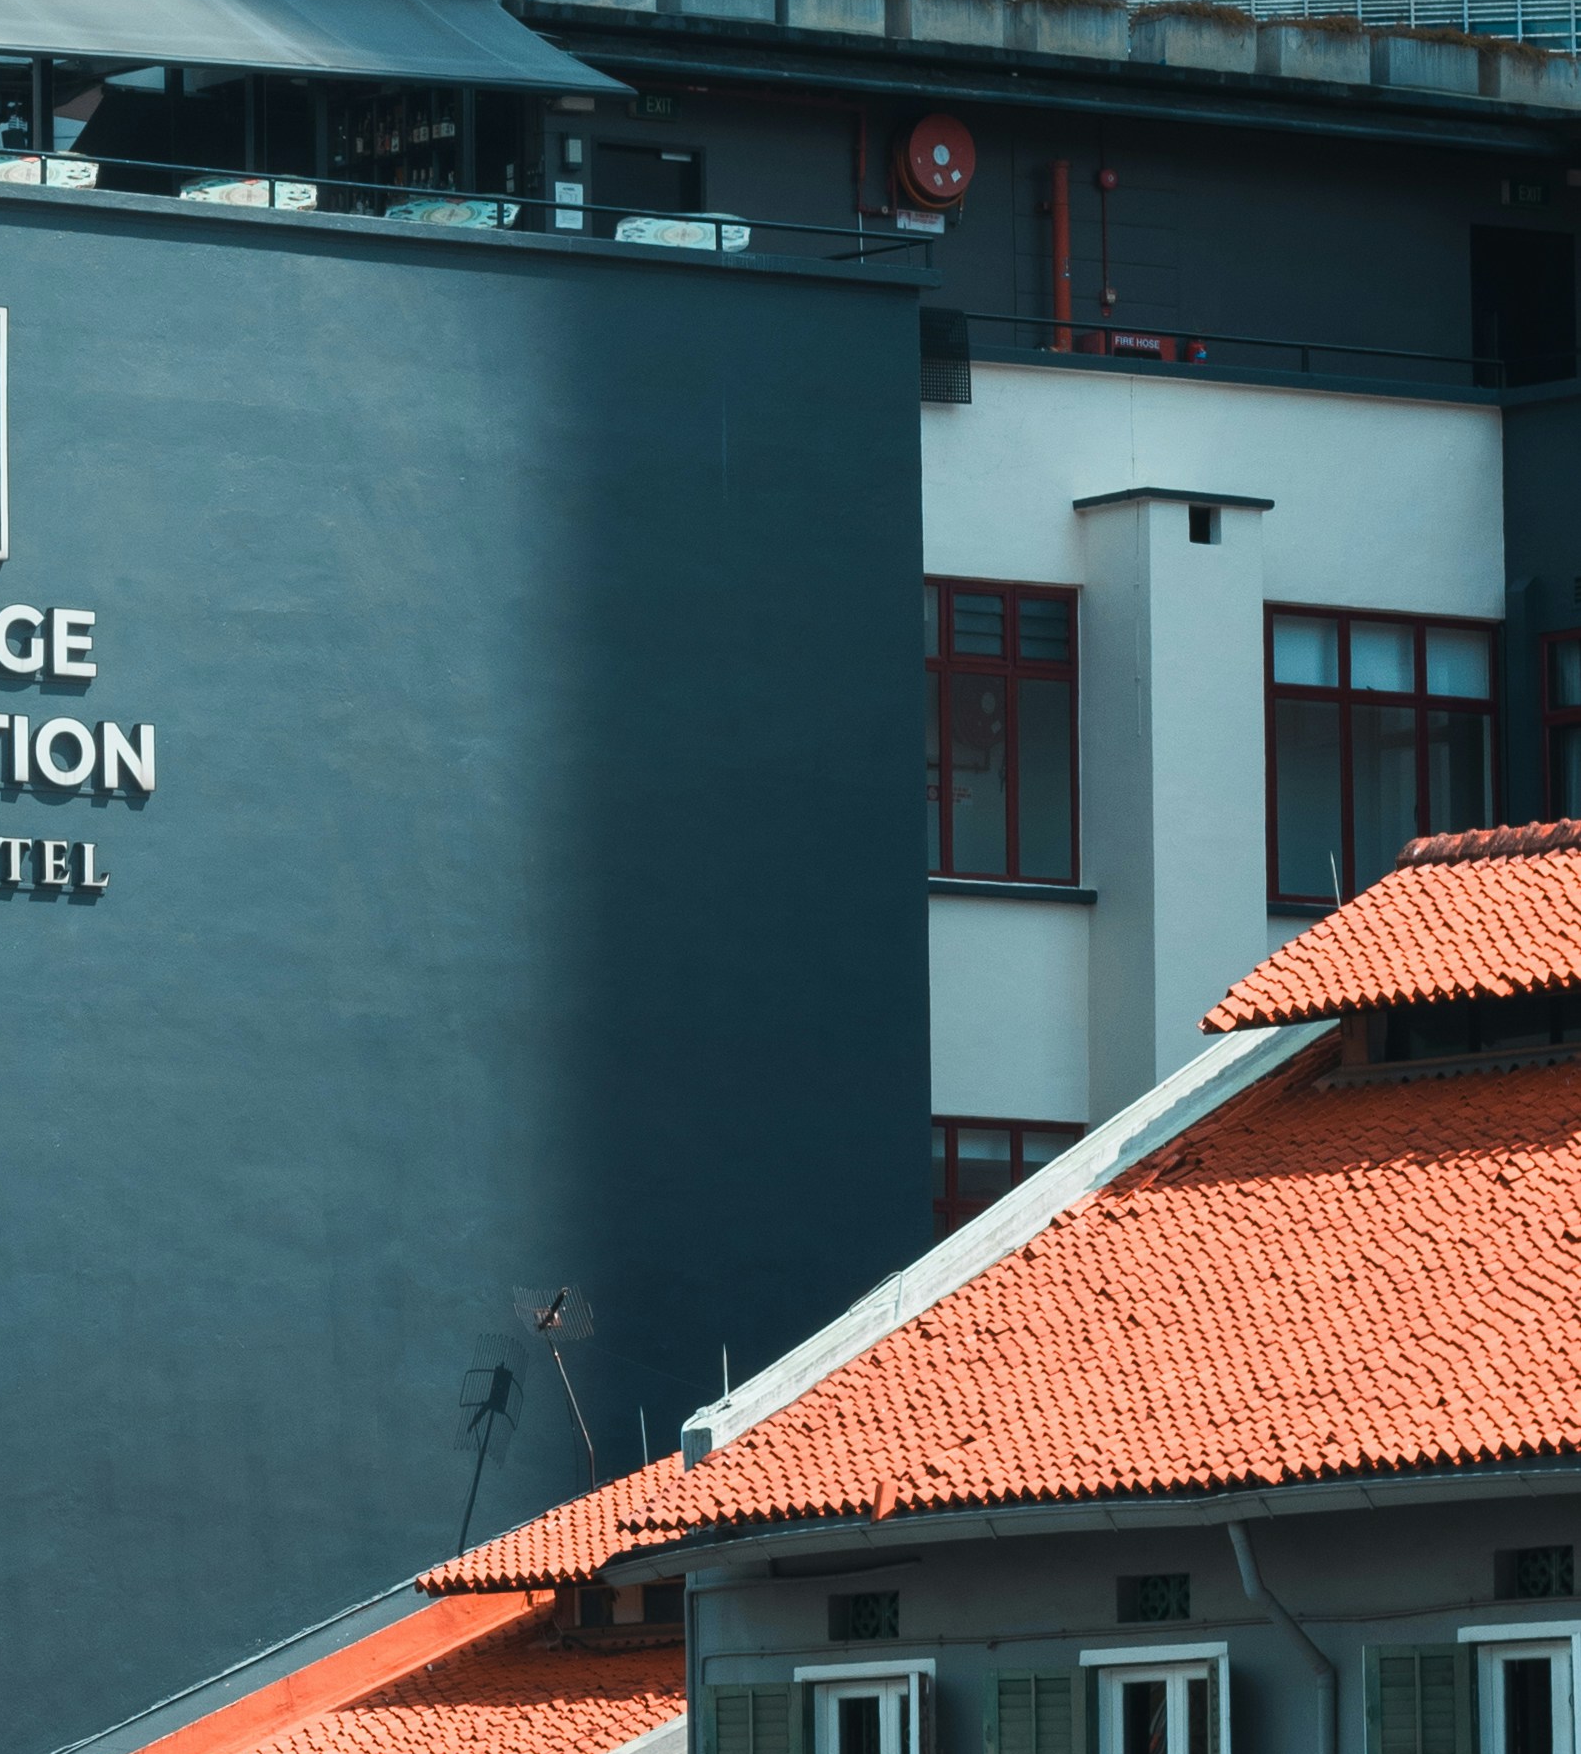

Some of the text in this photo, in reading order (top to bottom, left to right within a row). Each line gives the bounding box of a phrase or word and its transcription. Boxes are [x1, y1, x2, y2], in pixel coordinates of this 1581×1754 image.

[646, 96, 672, 114] EXIT
[1519, 185, 1542, 202] EXIT
[1114, 335, 1160, 349] FIRE HOSE
